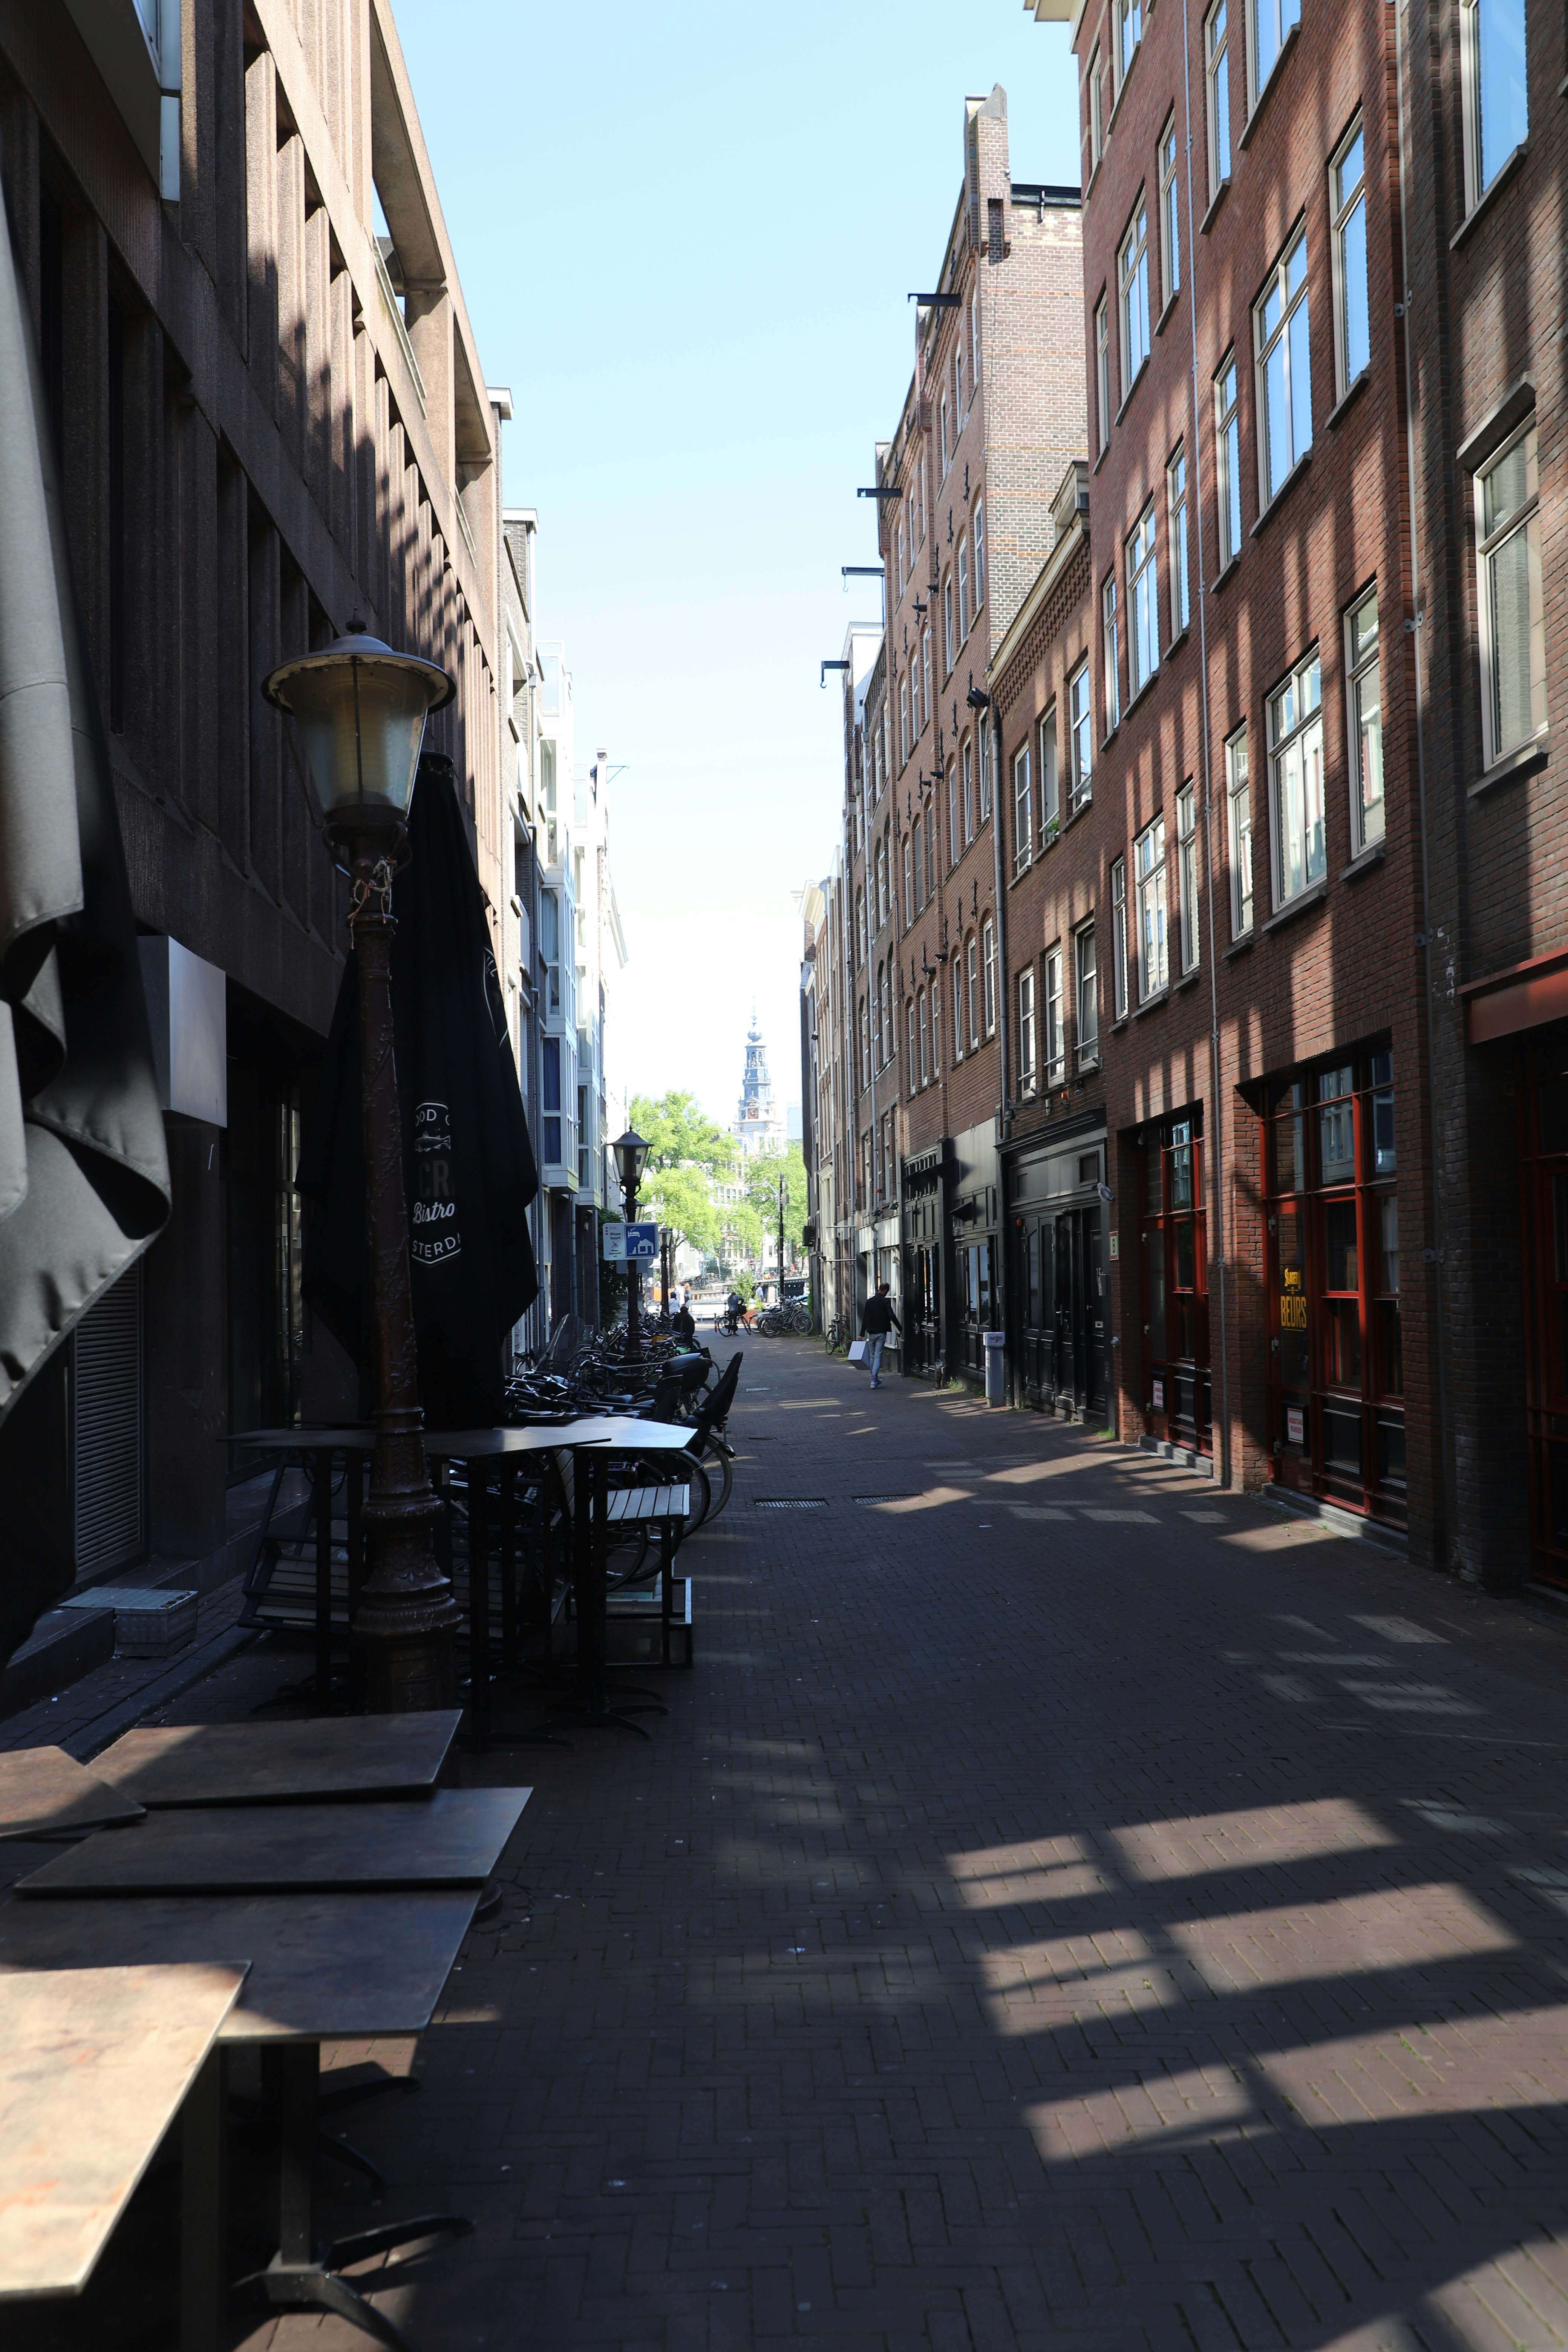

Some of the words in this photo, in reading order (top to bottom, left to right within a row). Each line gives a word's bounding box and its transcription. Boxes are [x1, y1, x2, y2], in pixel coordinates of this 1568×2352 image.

[419, 1160, 455, 1199] CR
[412, 1201, 455, 1224] Bistro
[1280, 1295, 1307, 1328] BEURS
